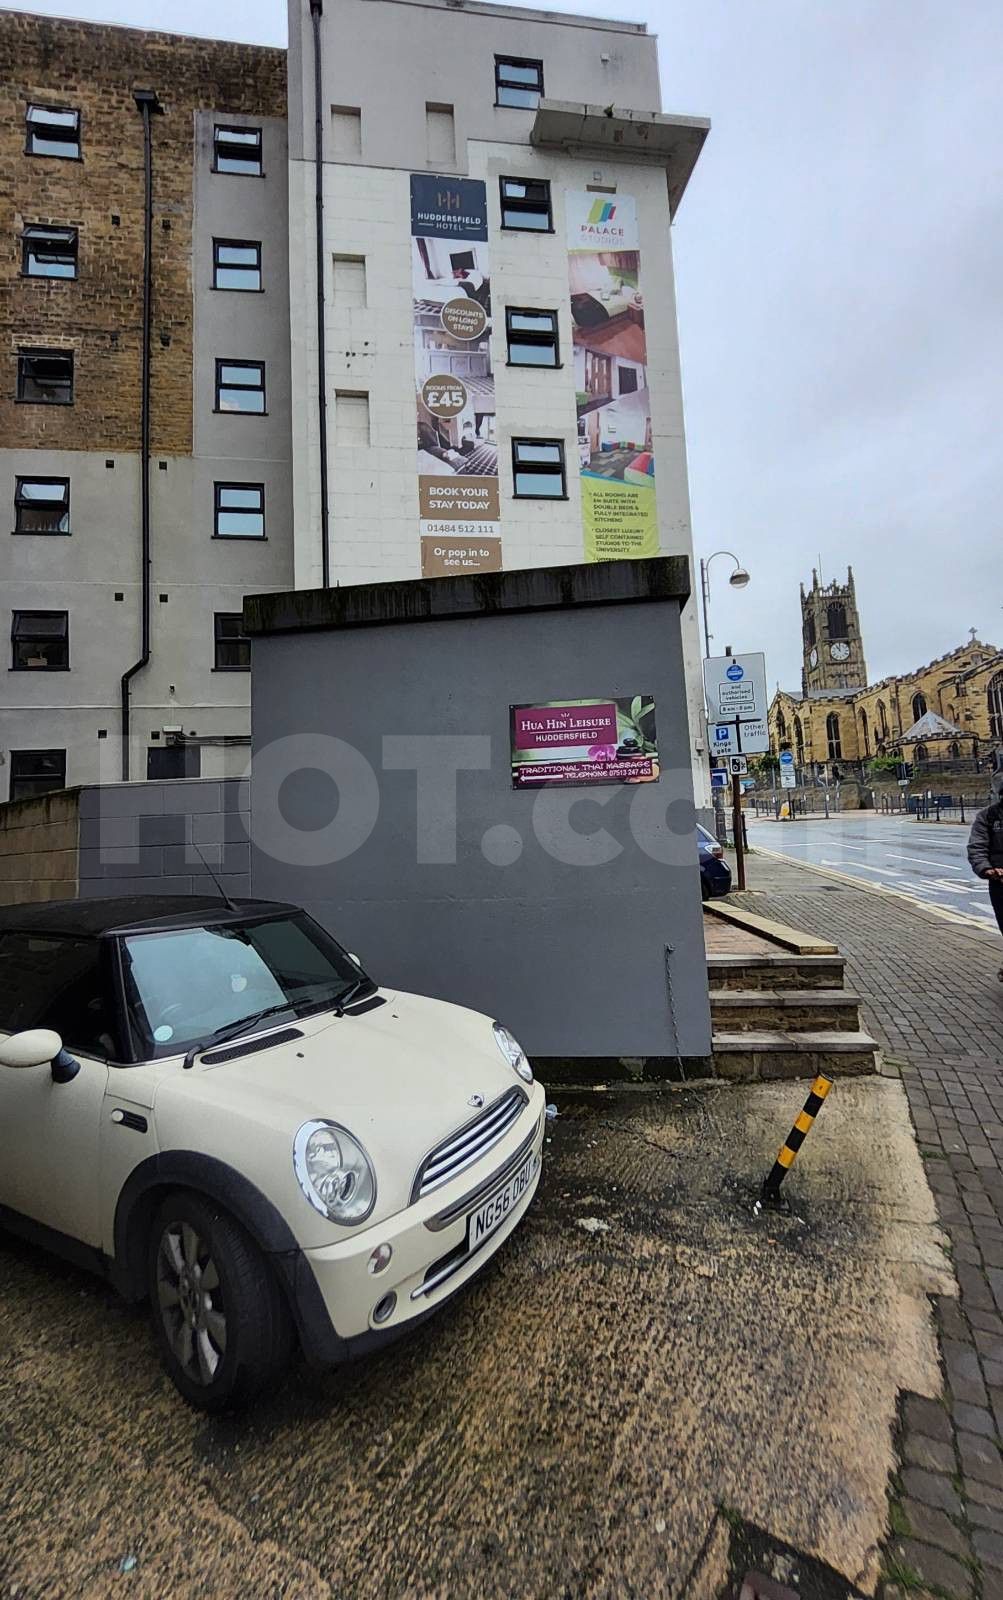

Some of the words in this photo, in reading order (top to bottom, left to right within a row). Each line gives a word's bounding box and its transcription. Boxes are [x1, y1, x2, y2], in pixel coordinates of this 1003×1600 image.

[417, 212, 481, 225] HUDDERSFIELD
[436, 222, 464, 231] HOTEL
[581, 225, 624, 237] PALACE
[444, 307, 484, 318] DISCOUNTS
[459, 317, 478, 325] LONG
[453, 323, 474, 332] STAYS
[427, 391, 464, 408] £45
[429, 486, 459, 496] BOOK
[460, 488, 489, 497] YOUR
[429, 500, 456, 509] STAY
[456, 501, 490, 510] TODAY
[427, 523, 456, 533] 01484
[457, 524, 475, 533] 512
[478, 525, 494, 533] 111
[433, 547, 446, 556] Or
[448, 548, 467, 558] pop
[469, 548, 477, 557] in
[479, 548, 490, 557] to
[535, 732, 598, 742] HUDDERSFIELD
[520, 764, 580, 774] TRADITIONAL
[581, 762, 604, 771] THAI
[605, 760, 651, 770] MASSAGE
[475, 1187, 511, 1241] NG56
